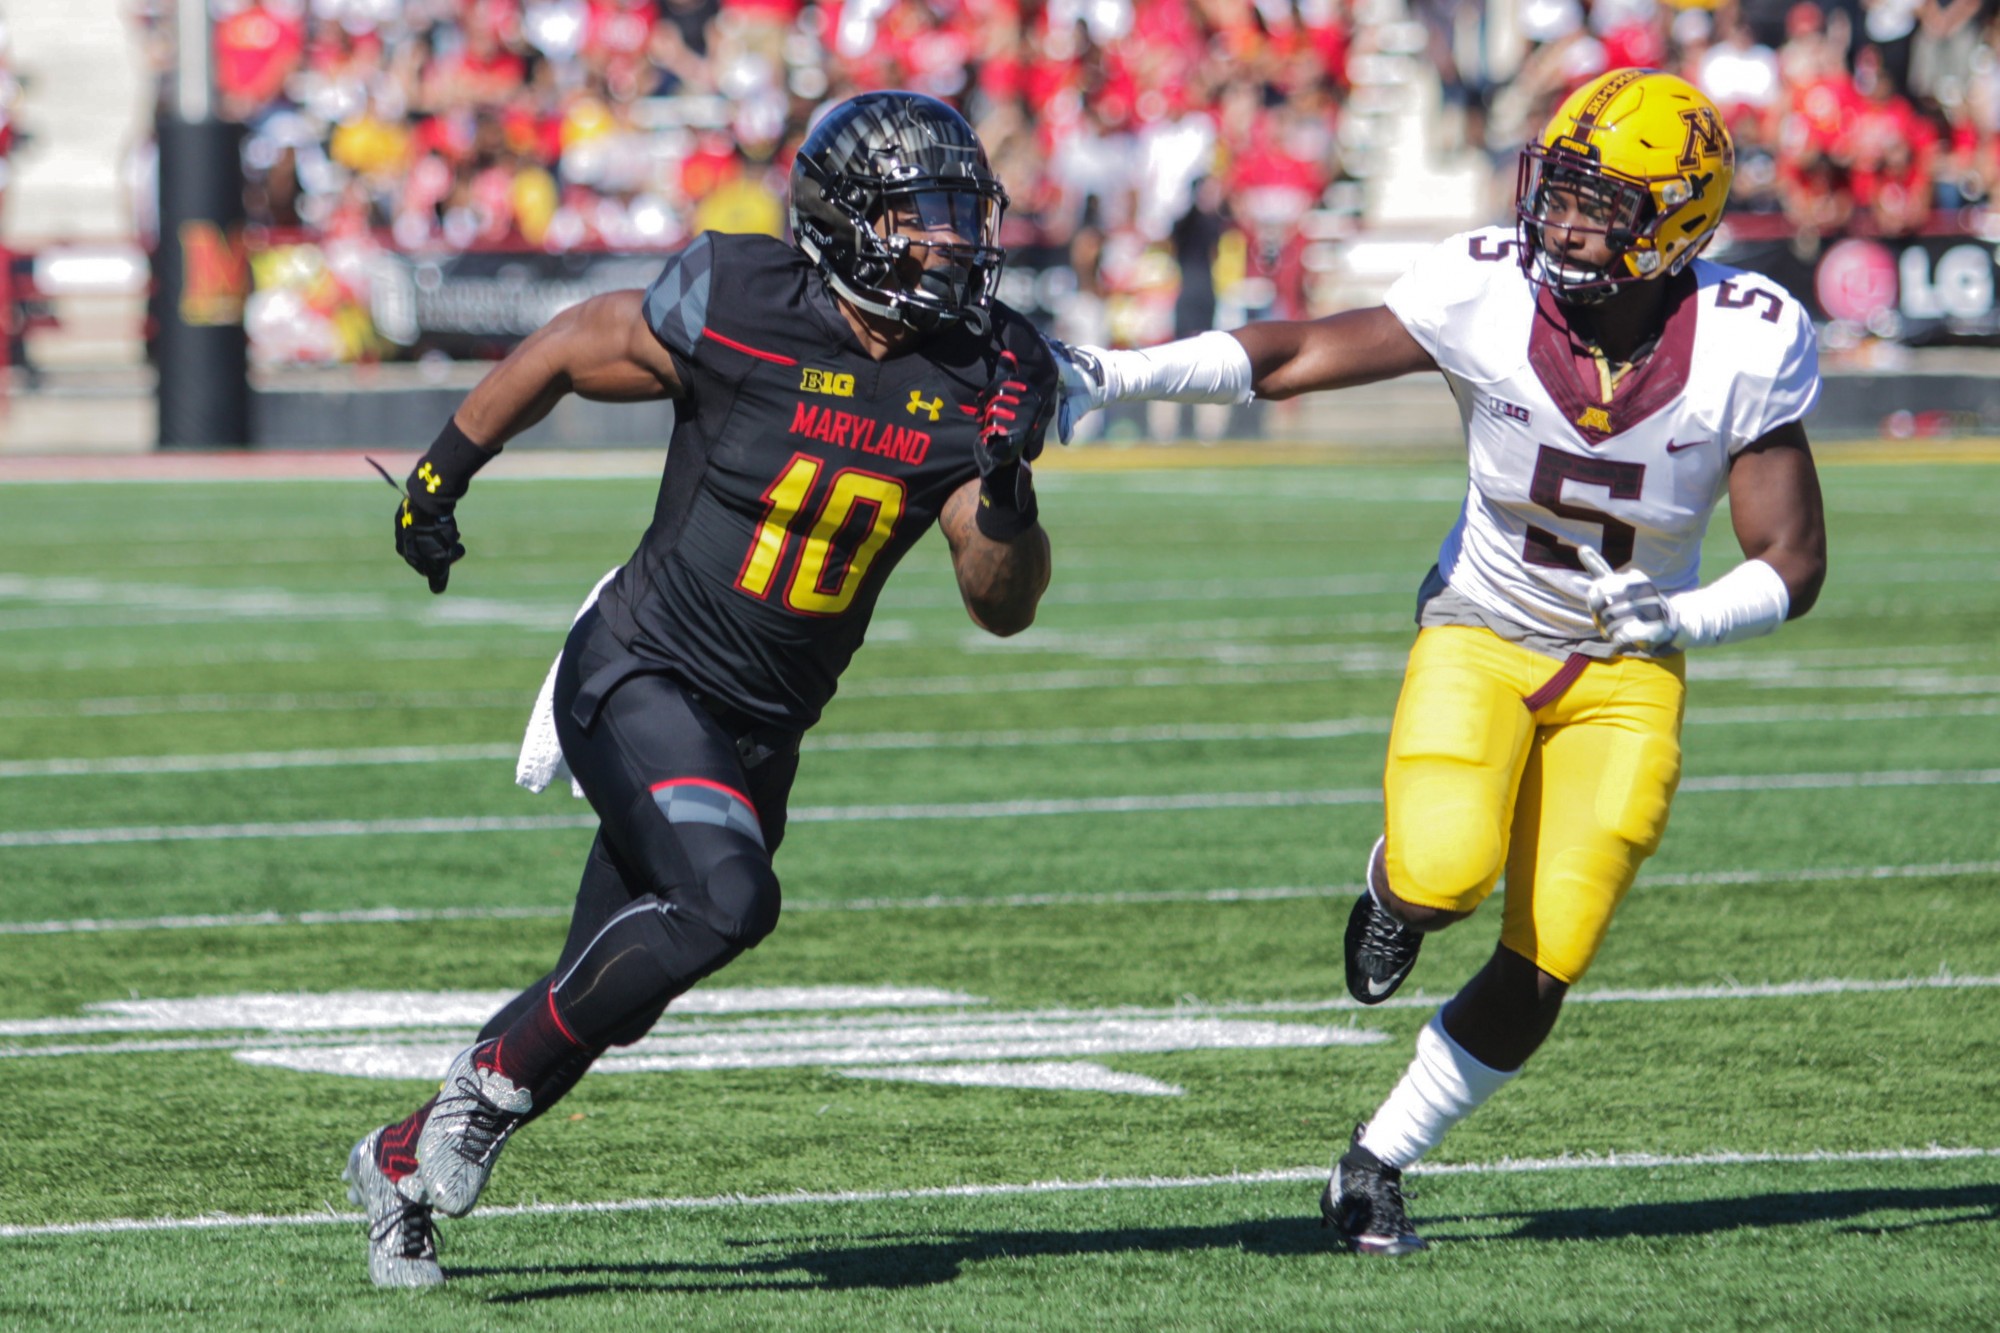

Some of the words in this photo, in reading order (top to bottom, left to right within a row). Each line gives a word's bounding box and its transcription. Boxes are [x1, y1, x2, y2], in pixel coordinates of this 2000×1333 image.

[1676, 107, 1735, 172] M
[1714, 279, 1784, 324] 5
[1899, 244, 1994, 319] LG
[790, 402, 931, 466] MARYLAND
[733, 452, 906, 617] 10
[1522, 443, 1646, 575] 5
